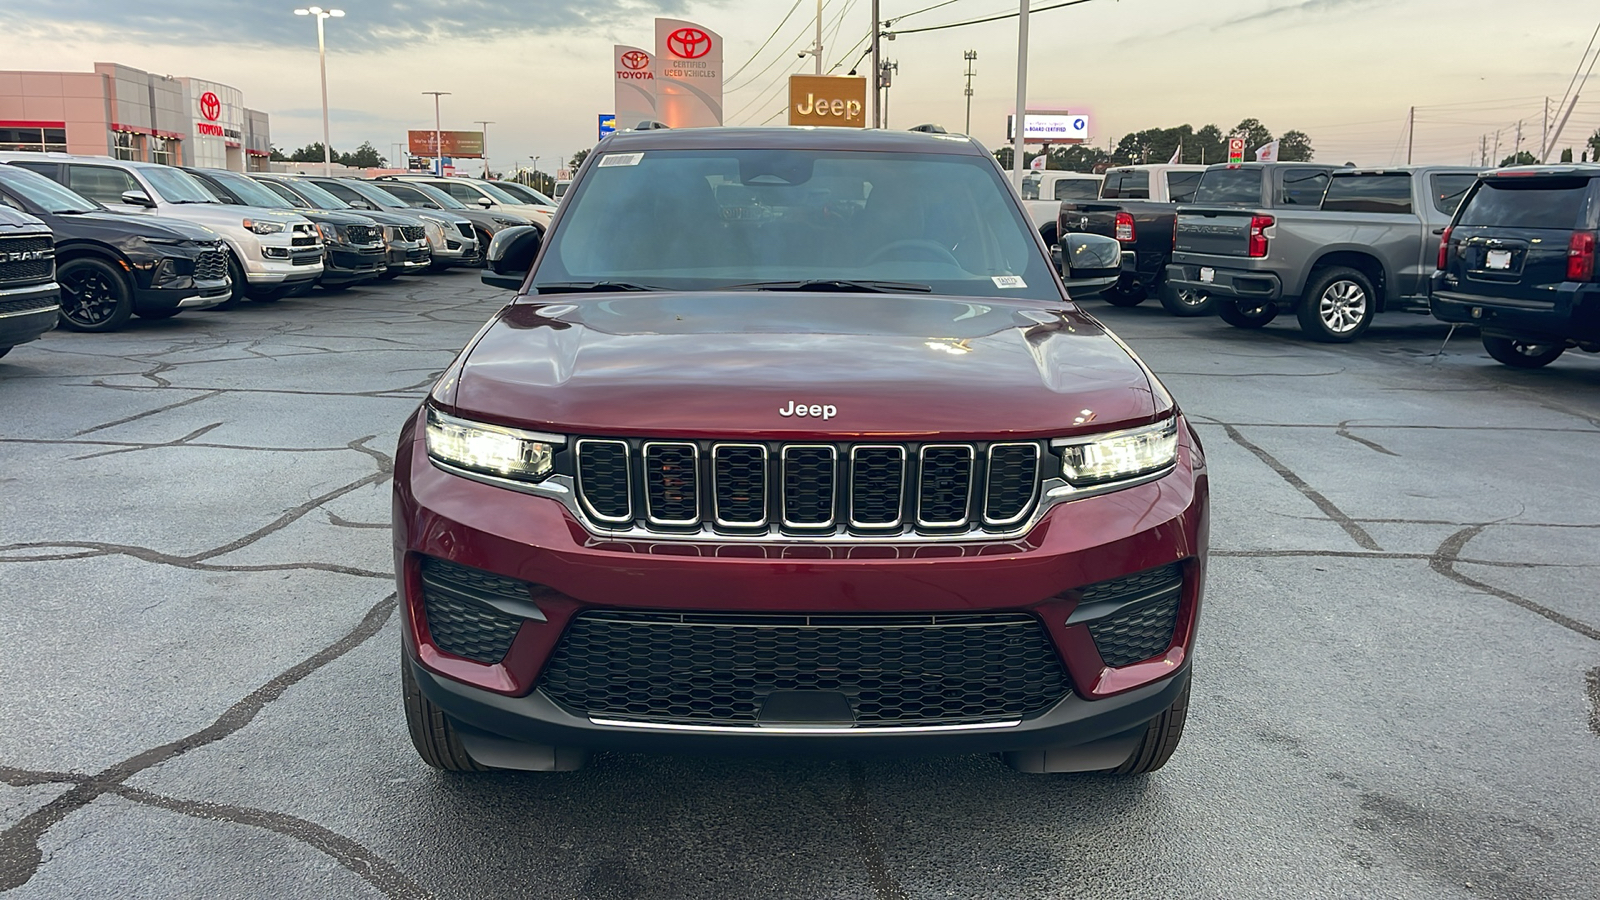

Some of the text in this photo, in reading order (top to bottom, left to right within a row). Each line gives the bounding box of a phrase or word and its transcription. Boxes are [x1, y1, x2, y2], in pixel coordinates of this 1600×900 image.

[673, 61, 707, 69] CERTIFIED
[616, 71, 654, 80] TOYOTA
[664, 69, 716, 78] USED VEHICLES
[797, 93, 861, 120] Jeep
[197, 123, 224, 136] TOYOTA
[9, 251, 43, 261] RAM
[779, 400, 837, 420] Jeep
